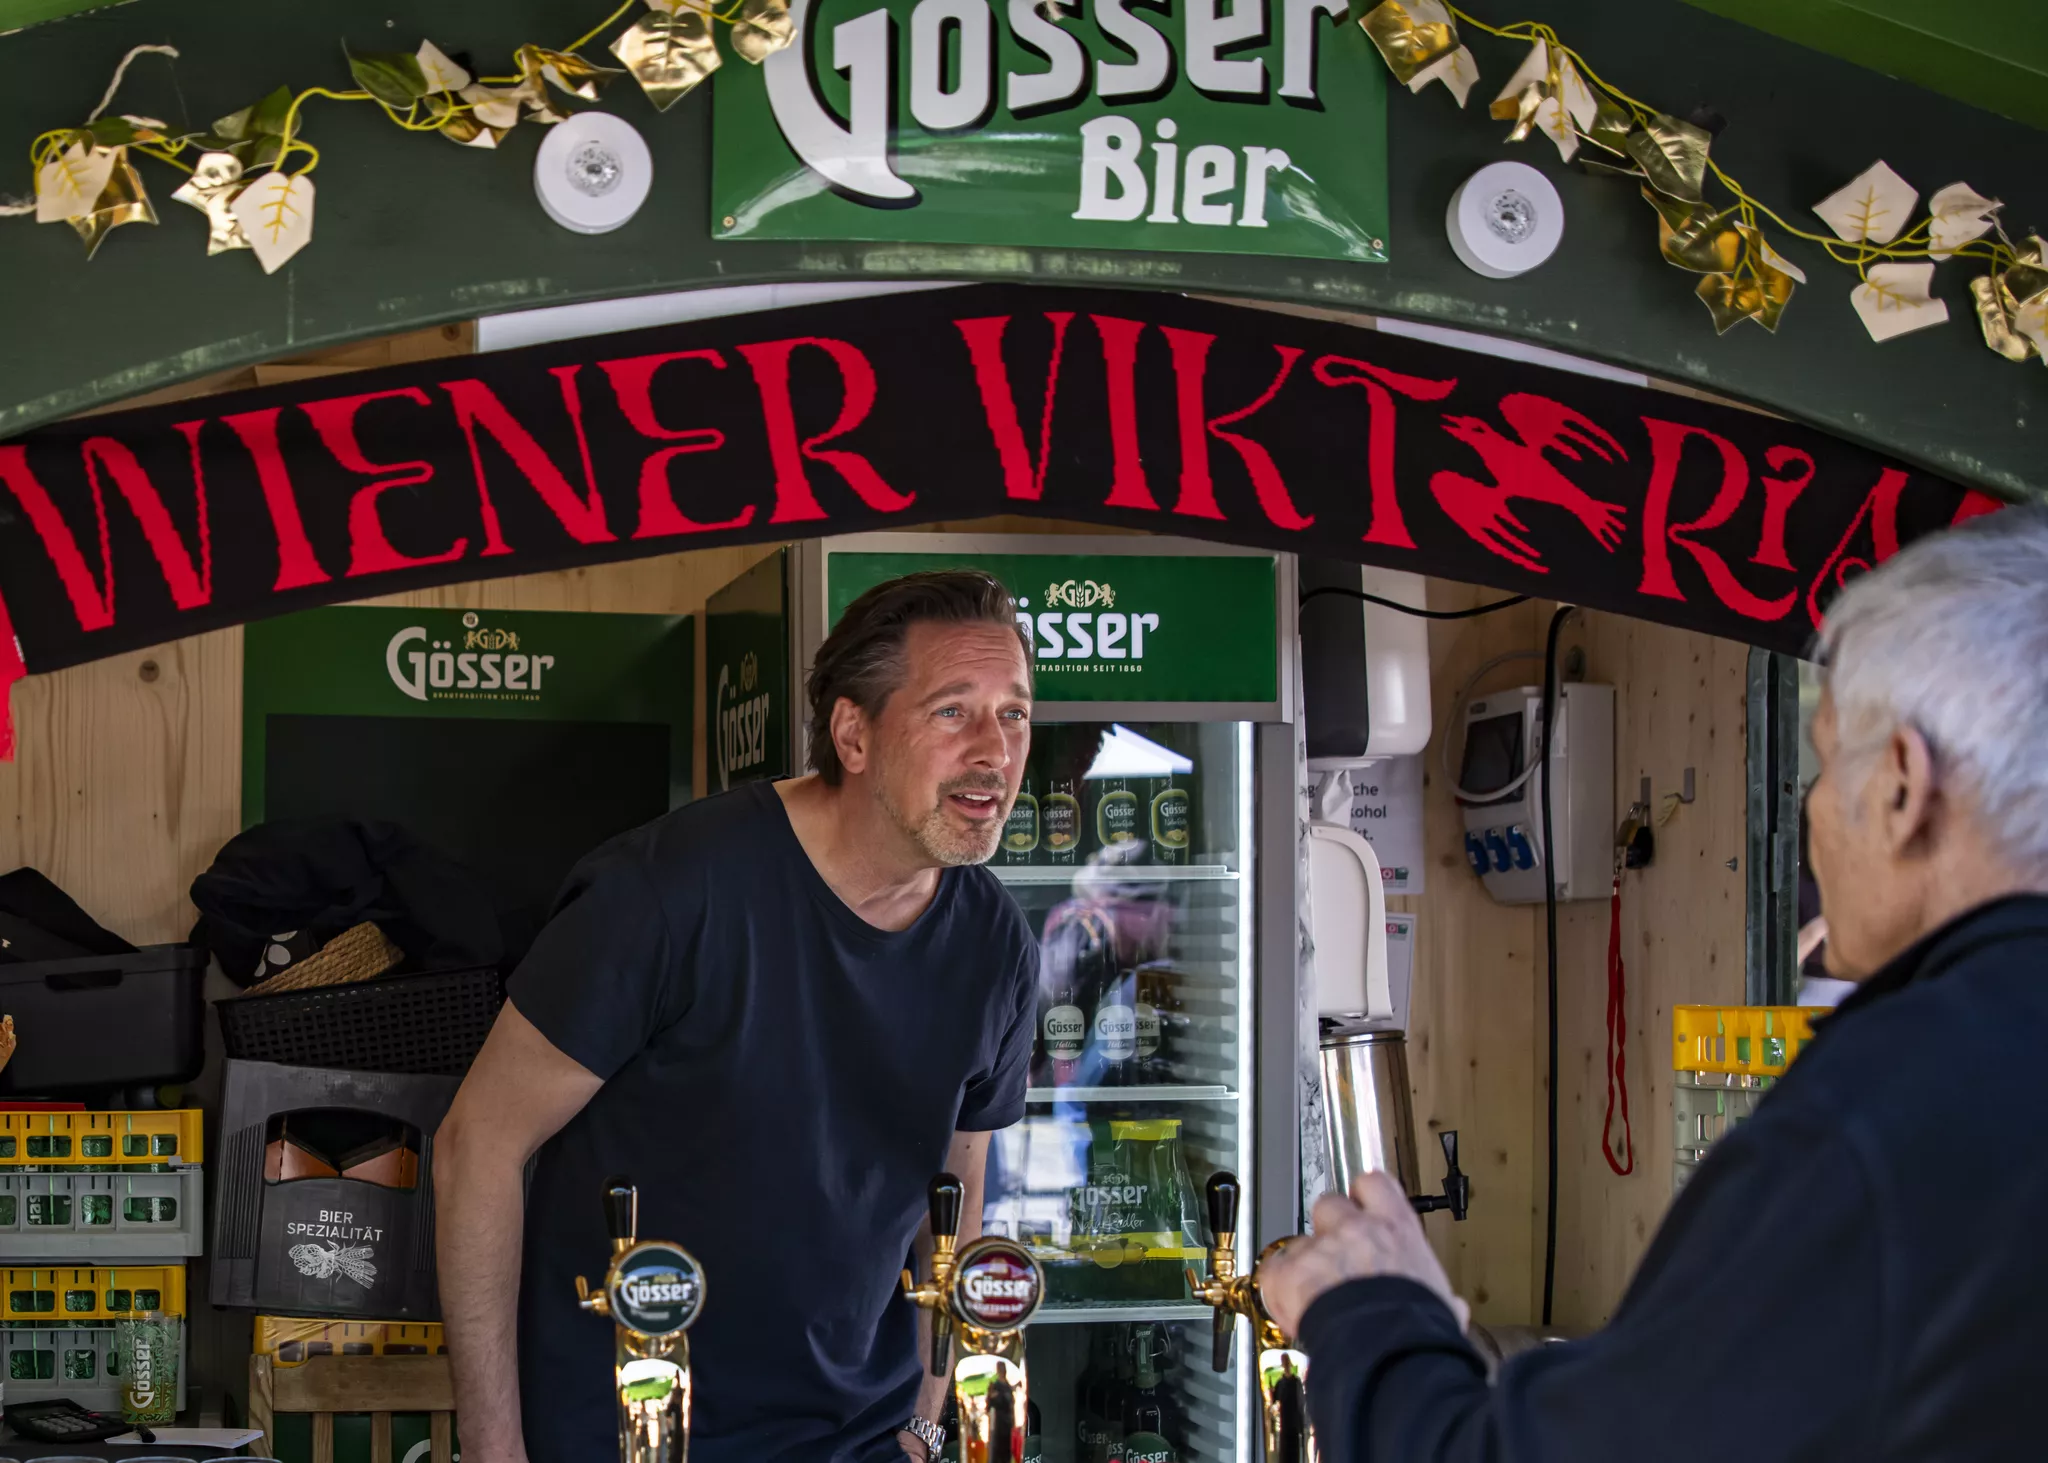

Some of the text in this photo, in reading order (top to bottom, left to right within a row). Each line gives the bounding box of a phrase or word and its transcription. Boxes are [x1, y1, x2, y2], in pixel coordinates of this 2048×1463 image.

[1070, 114, 1290, 228] Bier
[0, 312, 1910, 632] WIENER VIKTRIA
[1008, 597, 1160, 659] össer
[386, 626, 555, 701] Gösser
[1035, 664, 1143, 672] TRADITION SEIT 1860
[717, 664, 770, 791] Gösser
[1105, 803, 1136, 818] Gösser
[1350, 804, 1388, 819] ohol
[1047, 1018, 1083, 1036] Gösser
[1099, 1018, 1134, 1036] Gösser
[1135, 1019, 1157, 1030] sser
[319, 1209, 354, 1224] BIER
[287, 1222, 383, 1241] SPEZIALITÄT
[621, 1275, 692, 1308] Gösser
[965, 1270, 1032, 1301] Gösser
[130, 1337, 155, 1409] Gösser
